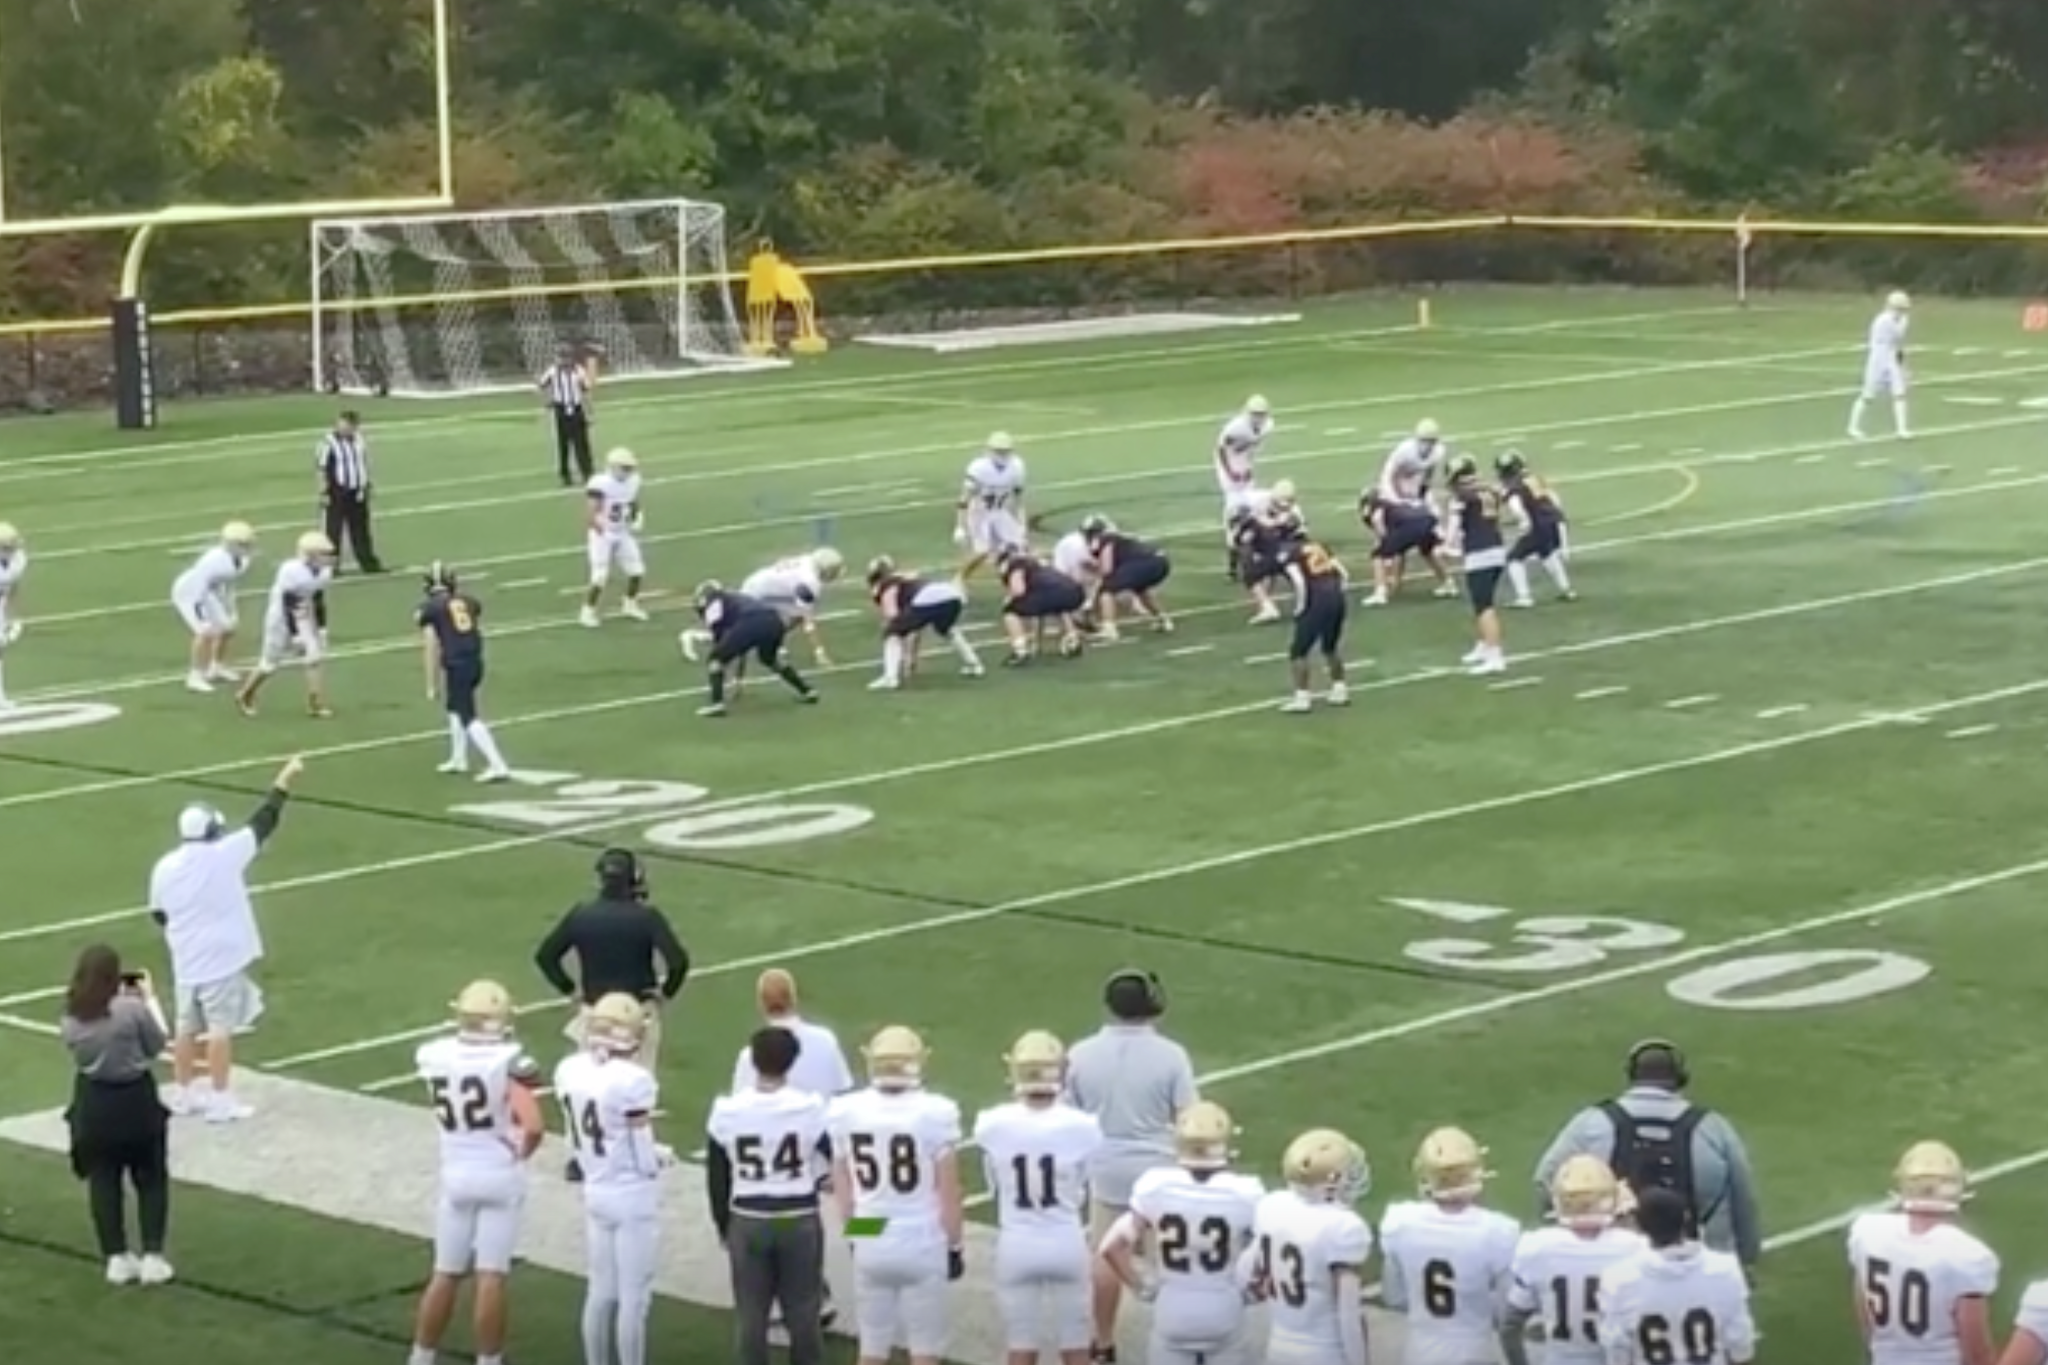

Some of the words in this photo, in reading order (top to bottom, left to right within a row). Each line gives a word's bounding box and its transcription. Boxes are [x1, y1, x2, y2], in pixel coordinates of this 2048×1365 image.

[1402, 916, 1932, 1009] 30
[431, 1076, 494, 1131] 52
[563, 1093, 606, 1157] 14
[735, 1133, 803, 1181] 54
[850, 1133, 918, 1193] 58
[1012, 1153, 1059, 1209] 11
[1158, 1214, 1231, 1273] 23
[1424, 1259, 1456, 1319] 6
[1867, 1257, 1930, 1337] 50
[1639, 1307, 1715, 1365] 60
